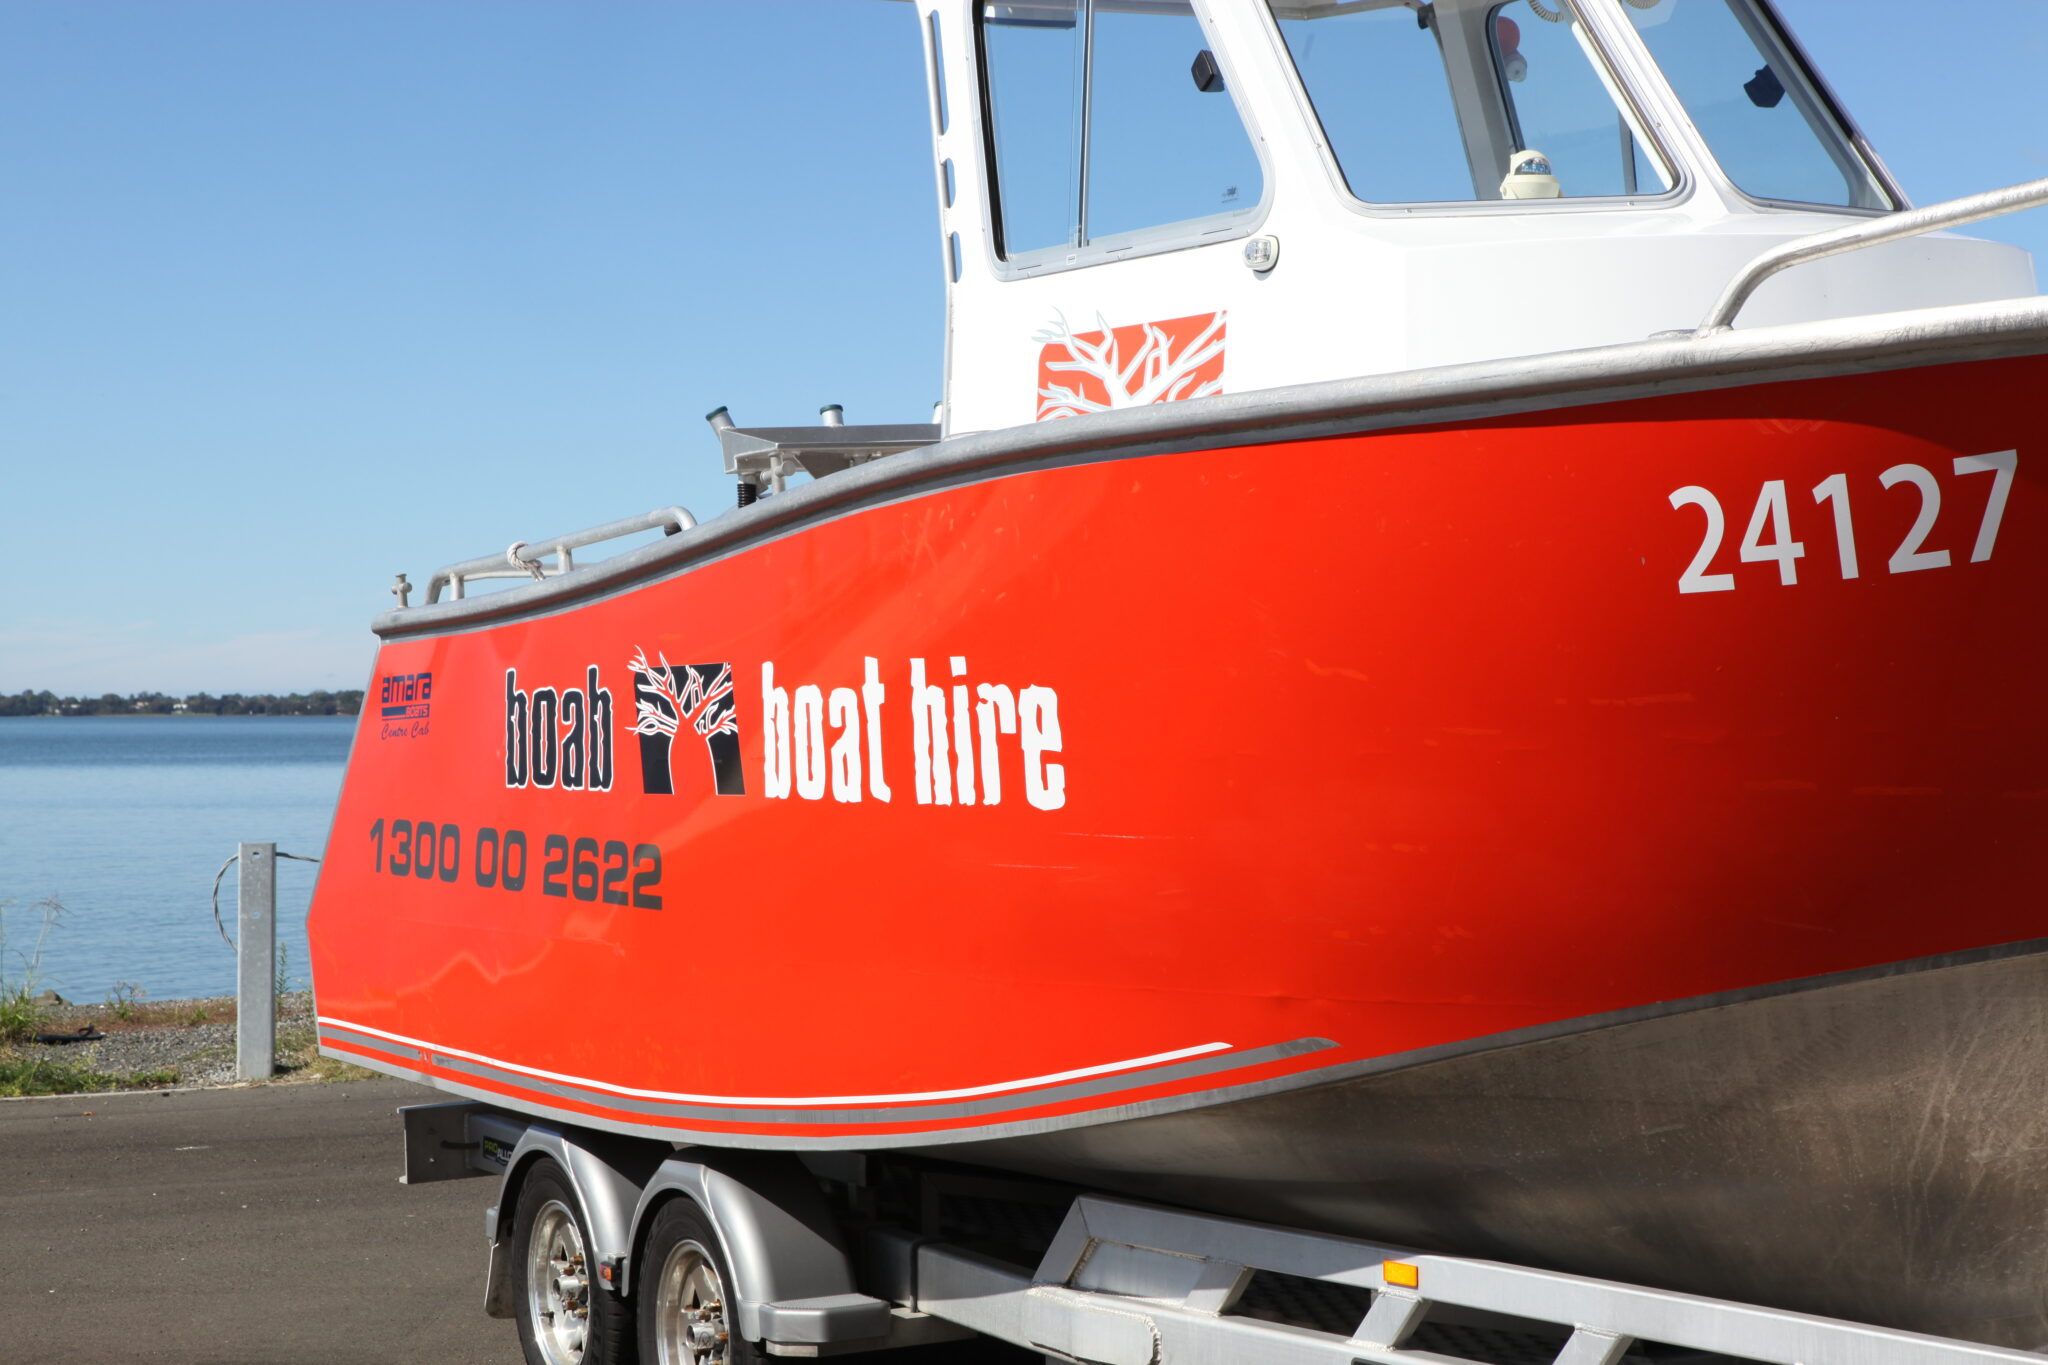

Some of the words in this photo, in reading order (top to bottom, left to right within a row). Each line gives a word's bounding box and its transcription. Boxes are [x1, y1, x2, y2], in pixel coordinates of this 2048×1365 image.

[1668, 449, 2019, 594] 24127
[381, 673, 432, 703] amara
[381, 723, 407, 740] Centre
[410, 721, 430, 737] Cab
[505, 664, 614, 792] boab
[762, 656, 891, 803] boat
[910, 656, 1066, 811] hire
[369, 818, 460, 883] 1300
[475, 827, 527, 892] 00
[543, 834, 663, 911] 2622
